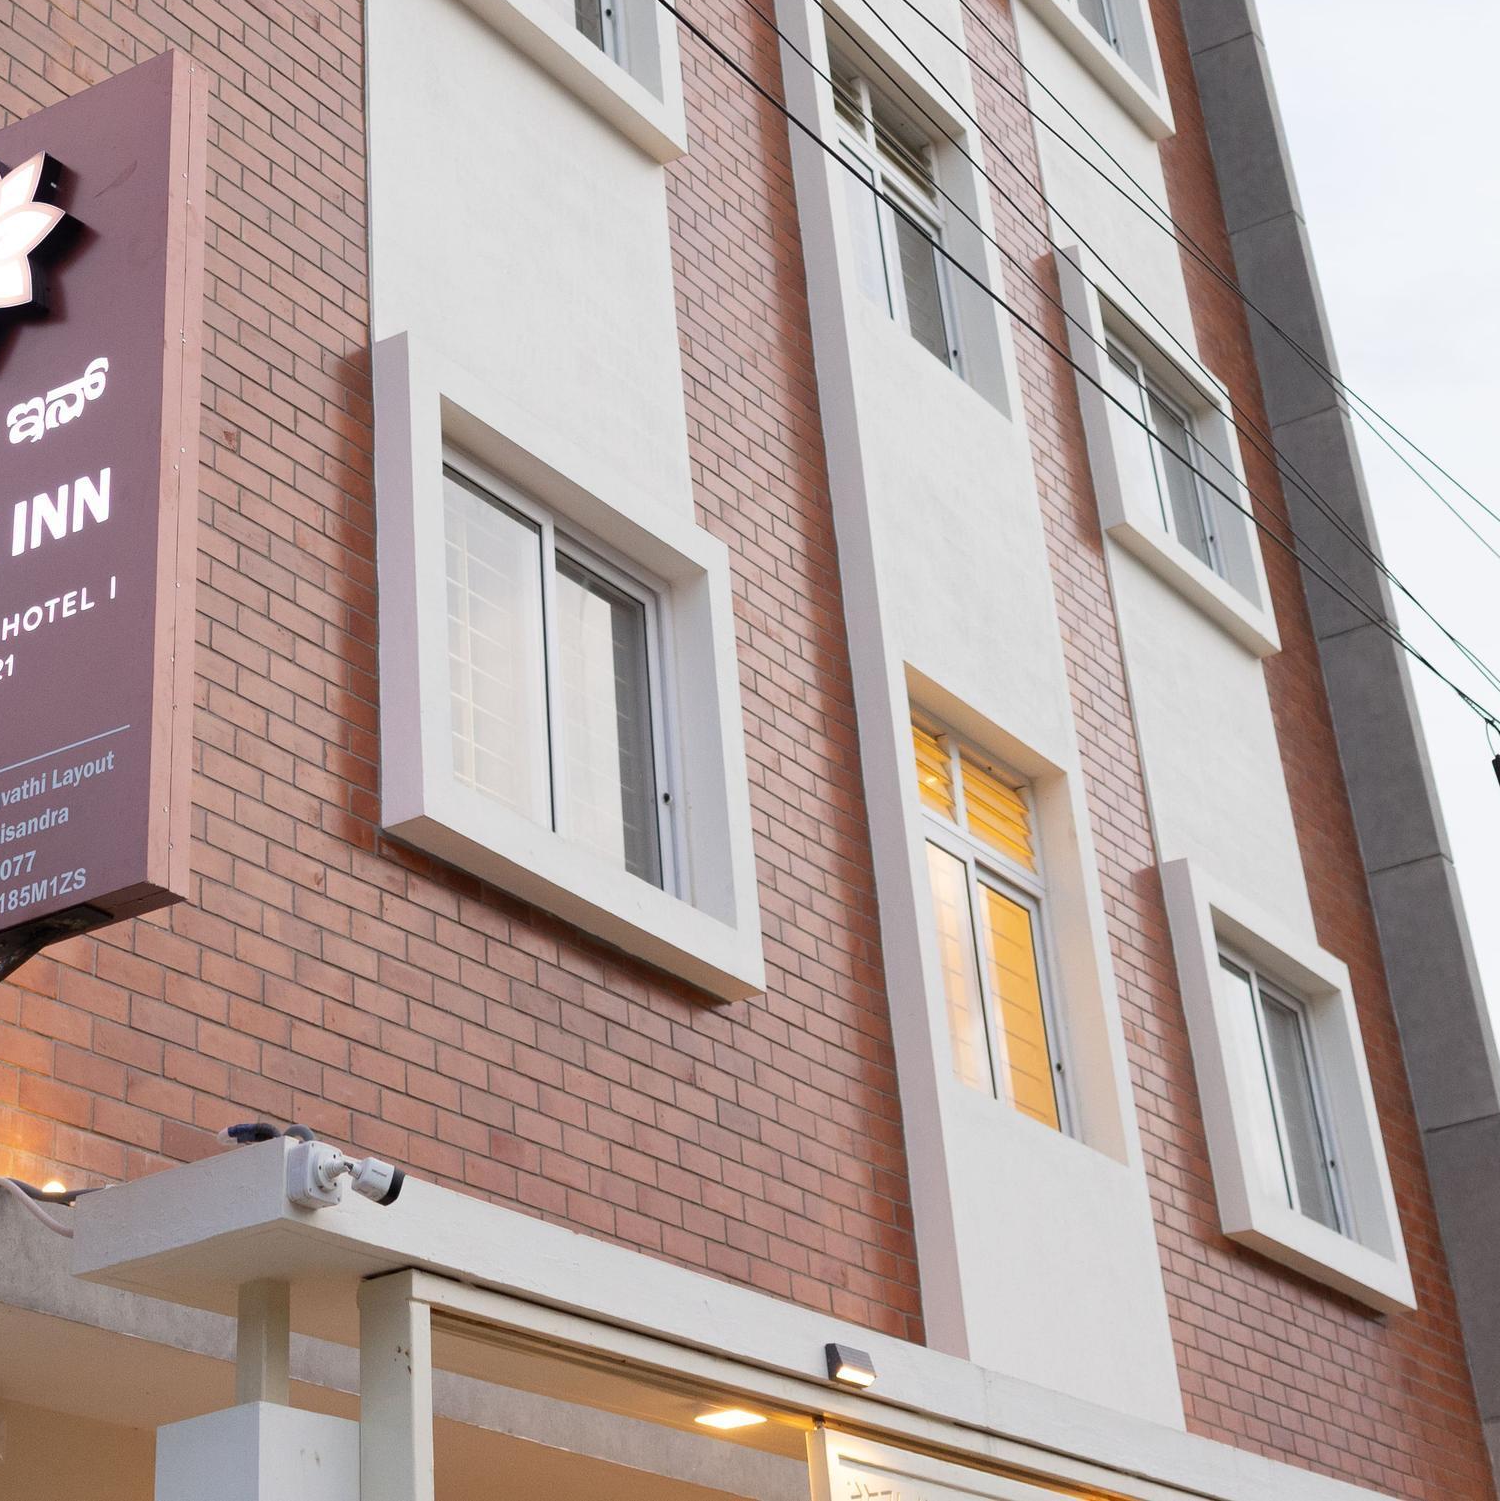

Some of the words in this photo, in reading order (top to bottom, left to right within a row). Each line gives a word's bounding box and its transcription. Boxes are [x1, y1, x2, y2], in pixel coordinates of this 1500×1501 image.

[6, 357, 109, 443] ಇನ್
[11, 467, 111, 557] INN
[1, 587, 96, 641] HOTEL
[51, 750, 115, 790] Layout
